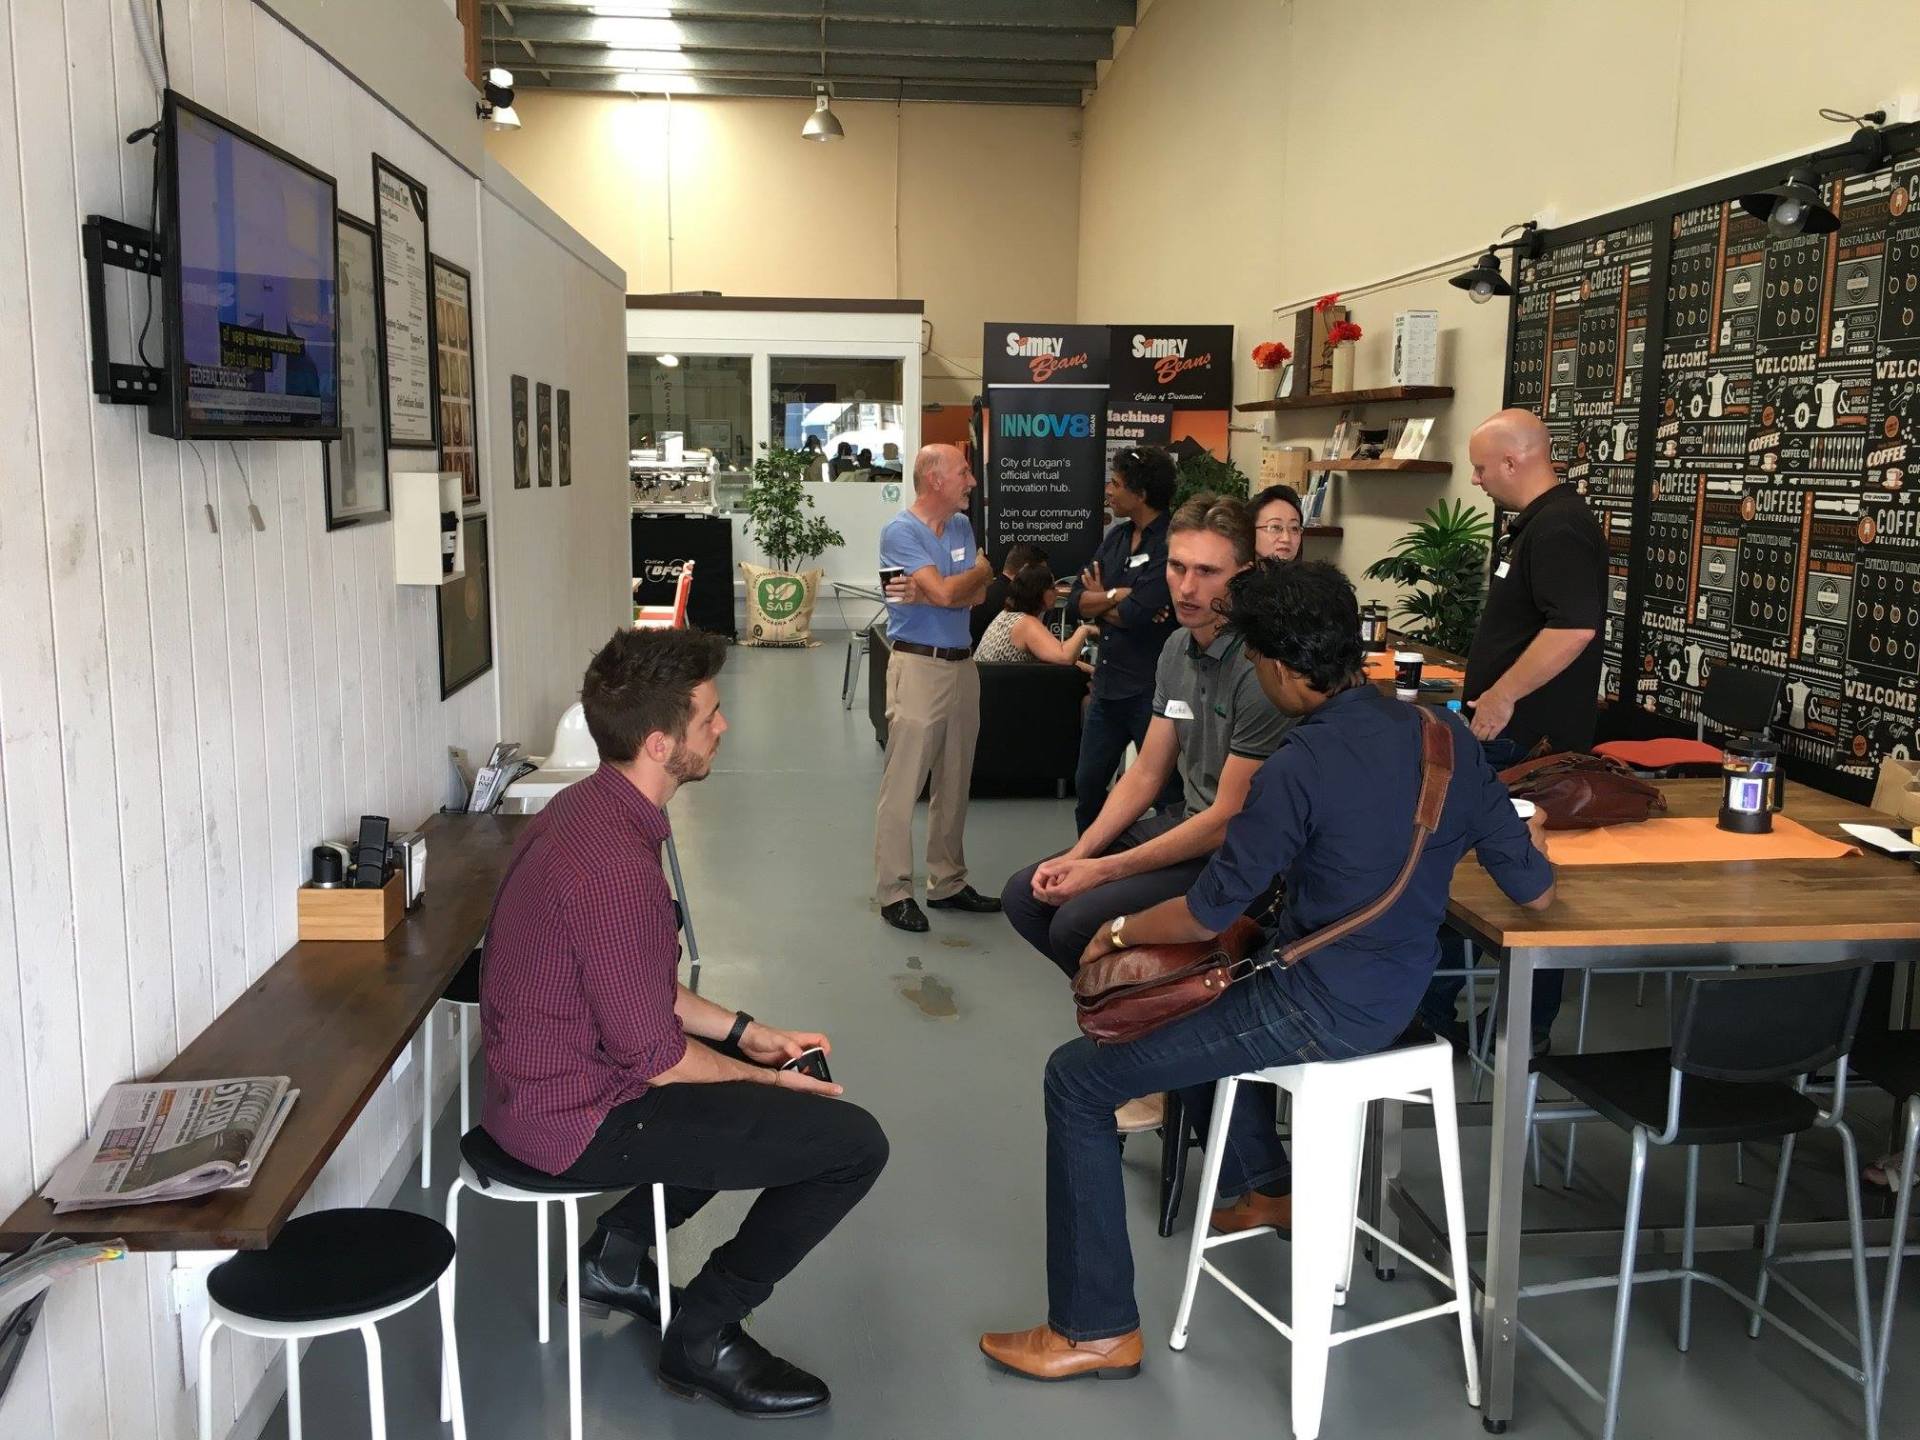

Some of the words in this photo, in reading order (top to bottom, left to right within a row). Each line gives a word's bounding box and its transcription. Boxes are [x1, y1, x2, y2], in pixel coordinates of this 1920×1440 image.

[1840, 230, 1886, 247] RESTAURANT
[1727, 241, 1765, 255] RESTAURANT
[1591, 266, 1622, 290] COFFEE
[1523, 293, 1550, 314] COFFEE
[1849, 344, 1869, 354] PRESS
[1029, 353, 1087, 382] Beans
[1154, 353, 1211, 384] Beans
[1755, 353, 1816, 375] WELCOME
[191, 368, 219, 385] FEDERAL
[220, 370, 246, 388] POLITICS
[1842, 379, 1871, 387] BREWING
[1725, 383, 1736, 404] &
[1851, 396, 1869, 404] GREAT
[1574, 402, 1614, 416] WELCOME
[1837, 390, 1850, 414] &
[1000, 414, 1089, 438] INNOV8
[1107, 426, 1144, 437] nders
[1656, 421, 1679, 439] OFFEE
[1749, 432, 1780, 452] COFFEE
[1781, 449, 1800, 458] COFFEE
[1867, 445, 1907, 467] COFFEE
[1001, 458, 1018, 468] City
[1021, 458, 1031, 467] of
[1033, 459, 1070, 468] Logan's
[1001, 471, 1029, 480] official
[1032, 471, 1059, 480] virtual
[1568, 464, 1590, 478] COFFEE
[1001, 483, 1047, 492] innovation
[1050, 483, 1070, 492] hub.
[1659, 473, 1698, 495] COFFEE
[1756, 489, 1803, 514] COFFEE
[1000, 508, 1019, 517] Join
[1040, 508, 1091, 519] community
[1012, 521, 1023, 529] be
[1027, 521, 1062, 531] inspired
[1065, 521, 1083, 529] and
[1704, 525, 1739, 536] RESTAURANT
[1000, 534, 1015, 543] get
[1018, 534, 1069, 542] connected!
[1810, 549, 1856, 562] RESTAURANT
[1865, 558, 1889, 571] ESPRESSO
[1889, 560, 1904, 572] FIELD
[1822, 642, 1839, 652] BREW
[1730, 641, 1787, 669] WELCOME
[1819, 657, 1838, 666] PRESS
[1637, 679, 1658, 691] OFFEE
[1844, 679, 1916, 713] WELCOME
[1808, 697, 1822, 721] &
[1883, 712, 1895, 721] FAIR
[1896, 714, 1914, 728] TRADE
